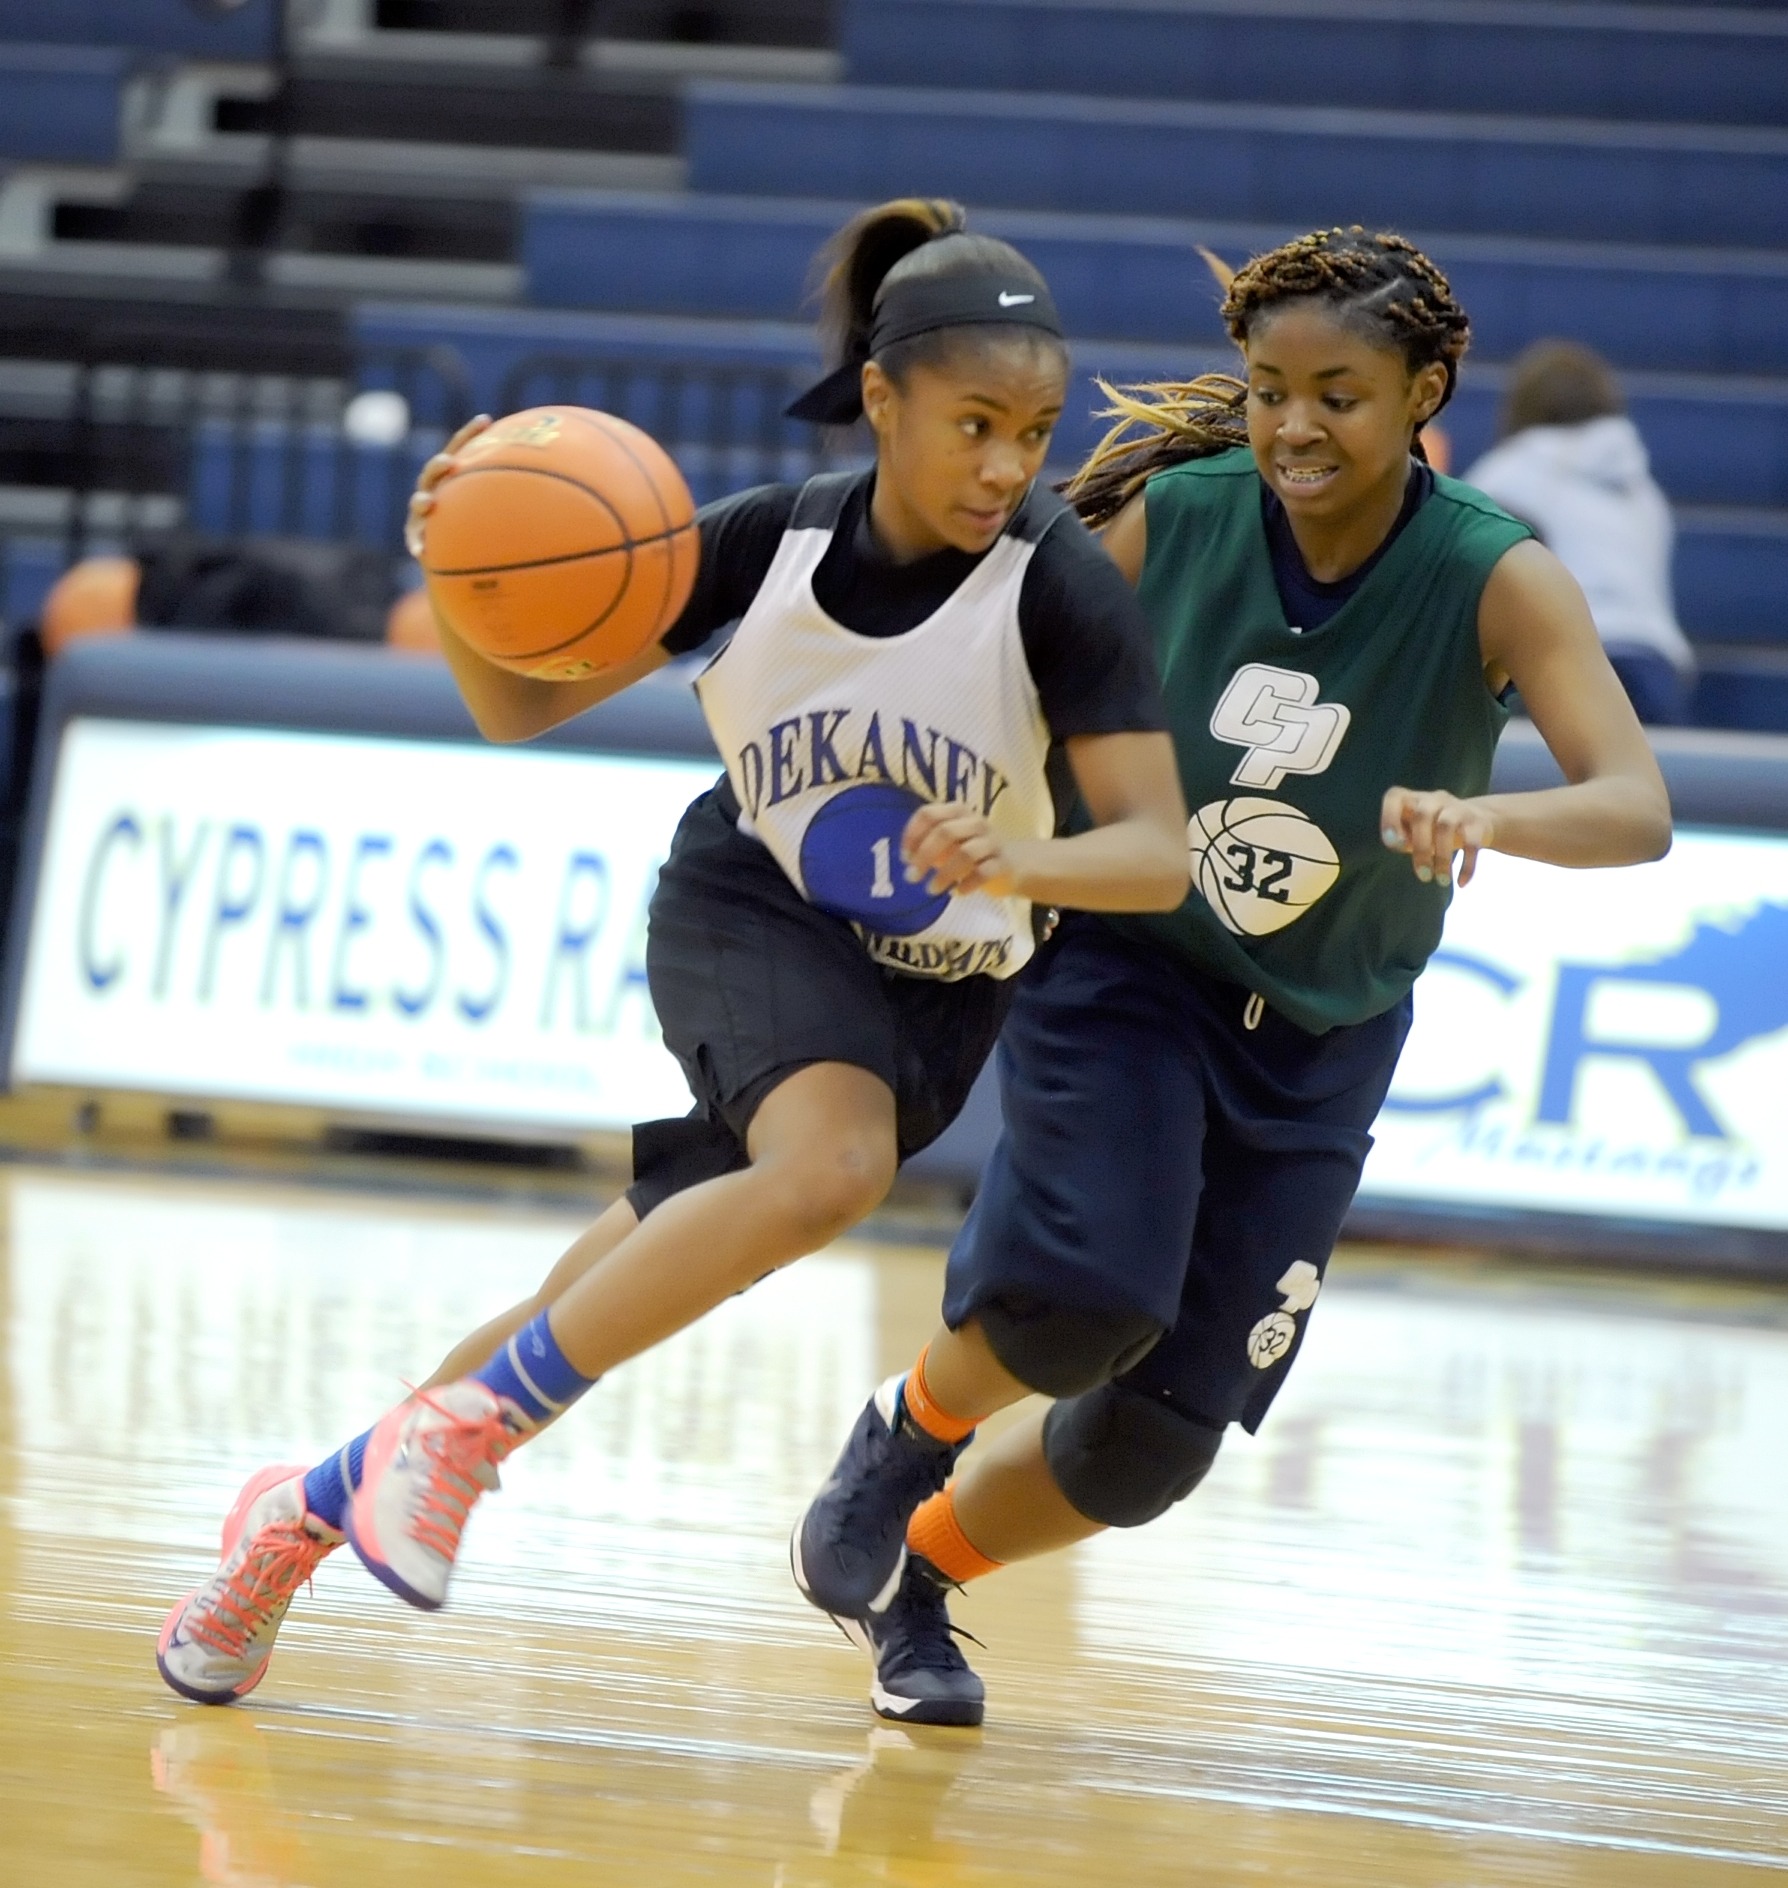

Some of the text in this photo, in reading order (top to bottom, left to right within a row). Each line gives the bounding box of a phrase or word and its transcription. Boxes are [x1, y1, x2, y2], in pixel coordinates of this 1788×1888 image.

[1209, 662, 1351, 791] CP
[870, 837, 894, 898] 1
[1223, 843, 1293, 902] 32
[77, 810, 519, 1025] CYPRESS
[1258, 1326, 1287, 1356] 32
